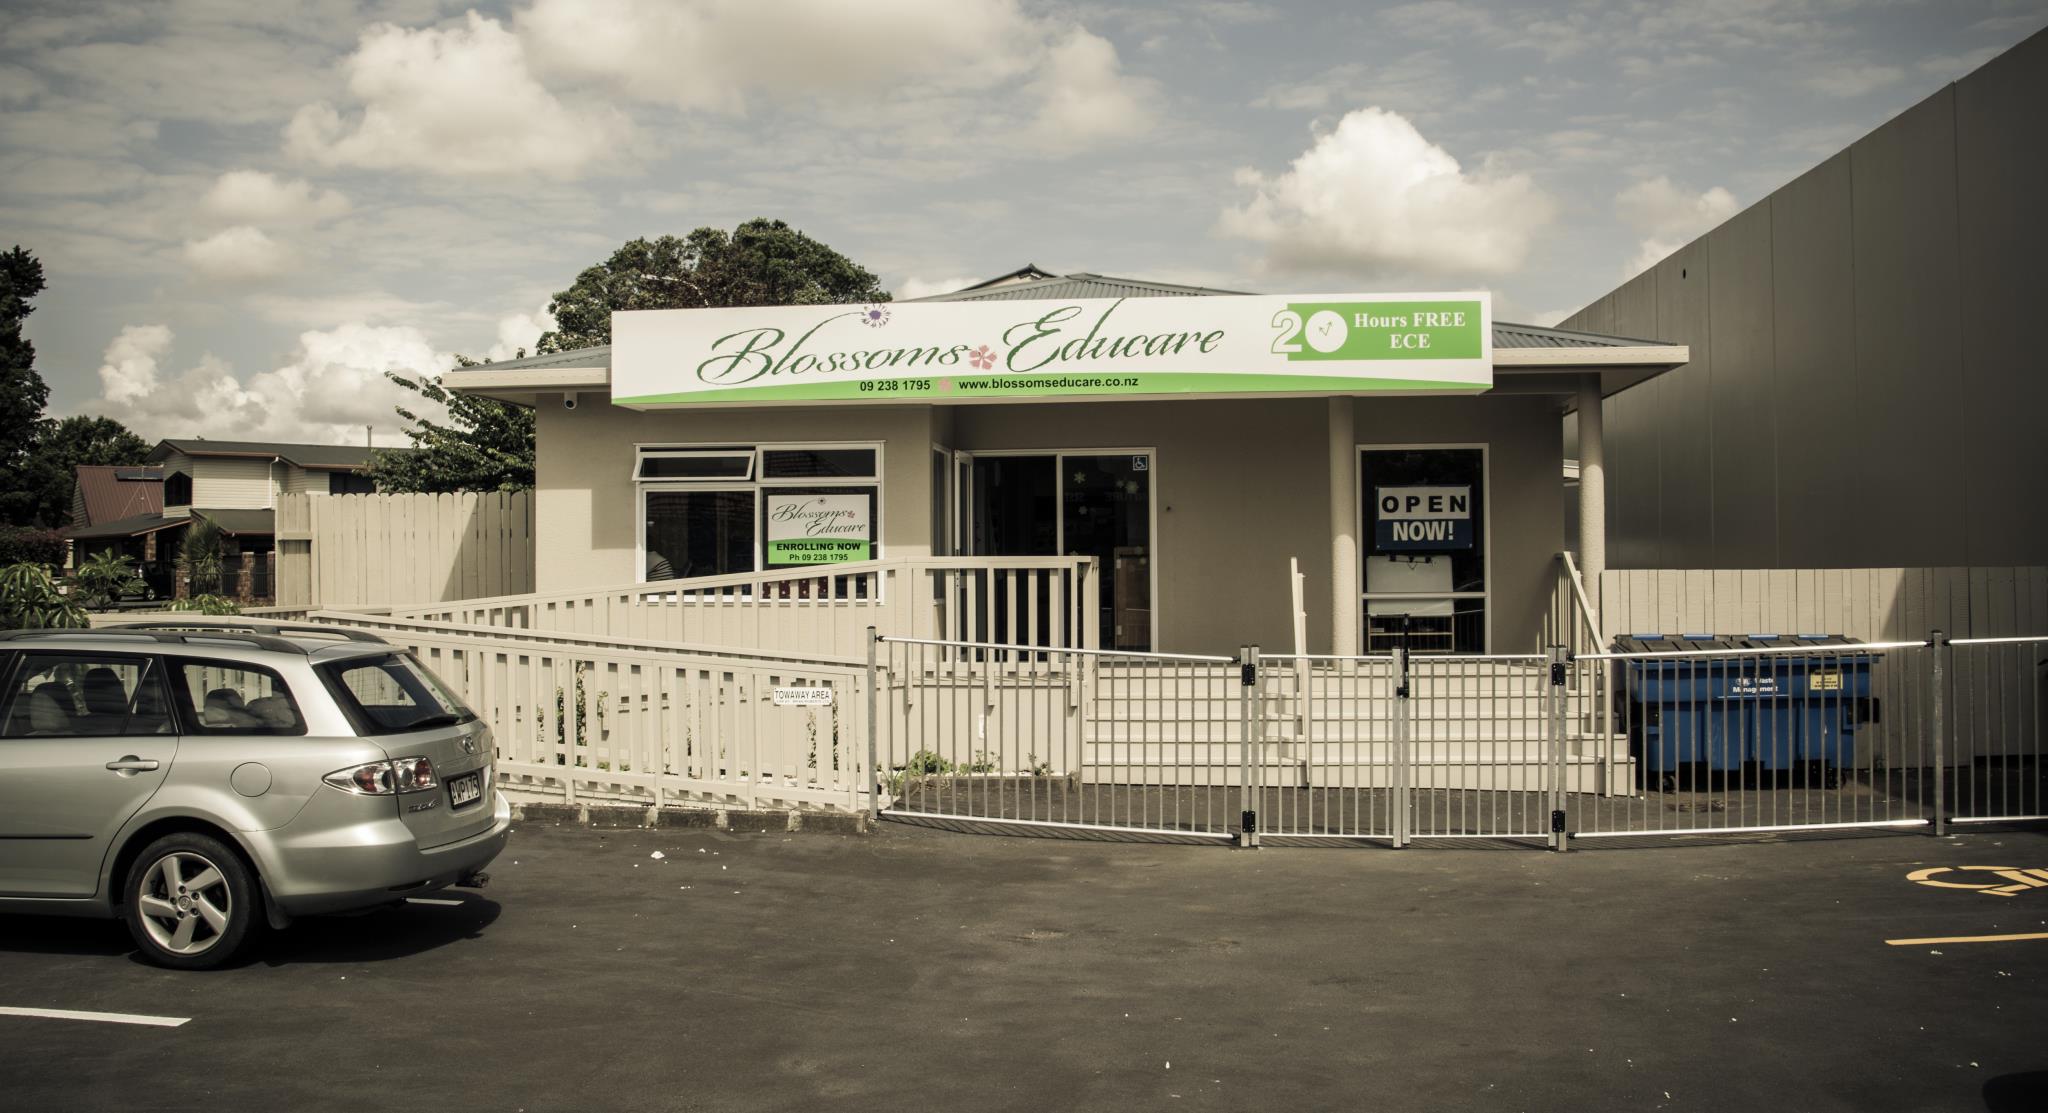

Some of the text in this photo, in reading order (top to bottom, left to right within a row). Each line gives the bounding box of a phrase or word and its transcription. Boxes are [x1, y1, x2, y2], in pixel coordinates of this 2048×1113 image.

[1271, 309, 1466, 354] 20 Hours FREE
[697, 297, 1224, 386] Blossoms Educare
[1389, 334, 1431, 349] ECE
[860, 379, 931, 391] 09 238 1795
[958, 377, 1139, 390] www.blossomseducare.co.nz
[771, 499, 848, 522] Blossoms
[1381, 495, 1467, 513] OPEN
[805, 516, 866, 537] Educare
[1392, 520, 1454, 541] NOW!
[776, 543, 861, 551] ENROLLING NOW
[802, 553, 812, 561] 09
[813, 553, 828, 561] 238
[830, 553, 849, 561] 1795
[811, 690, 830, 699] AREA
[1732, 686, 1779, 694] Mnagment
